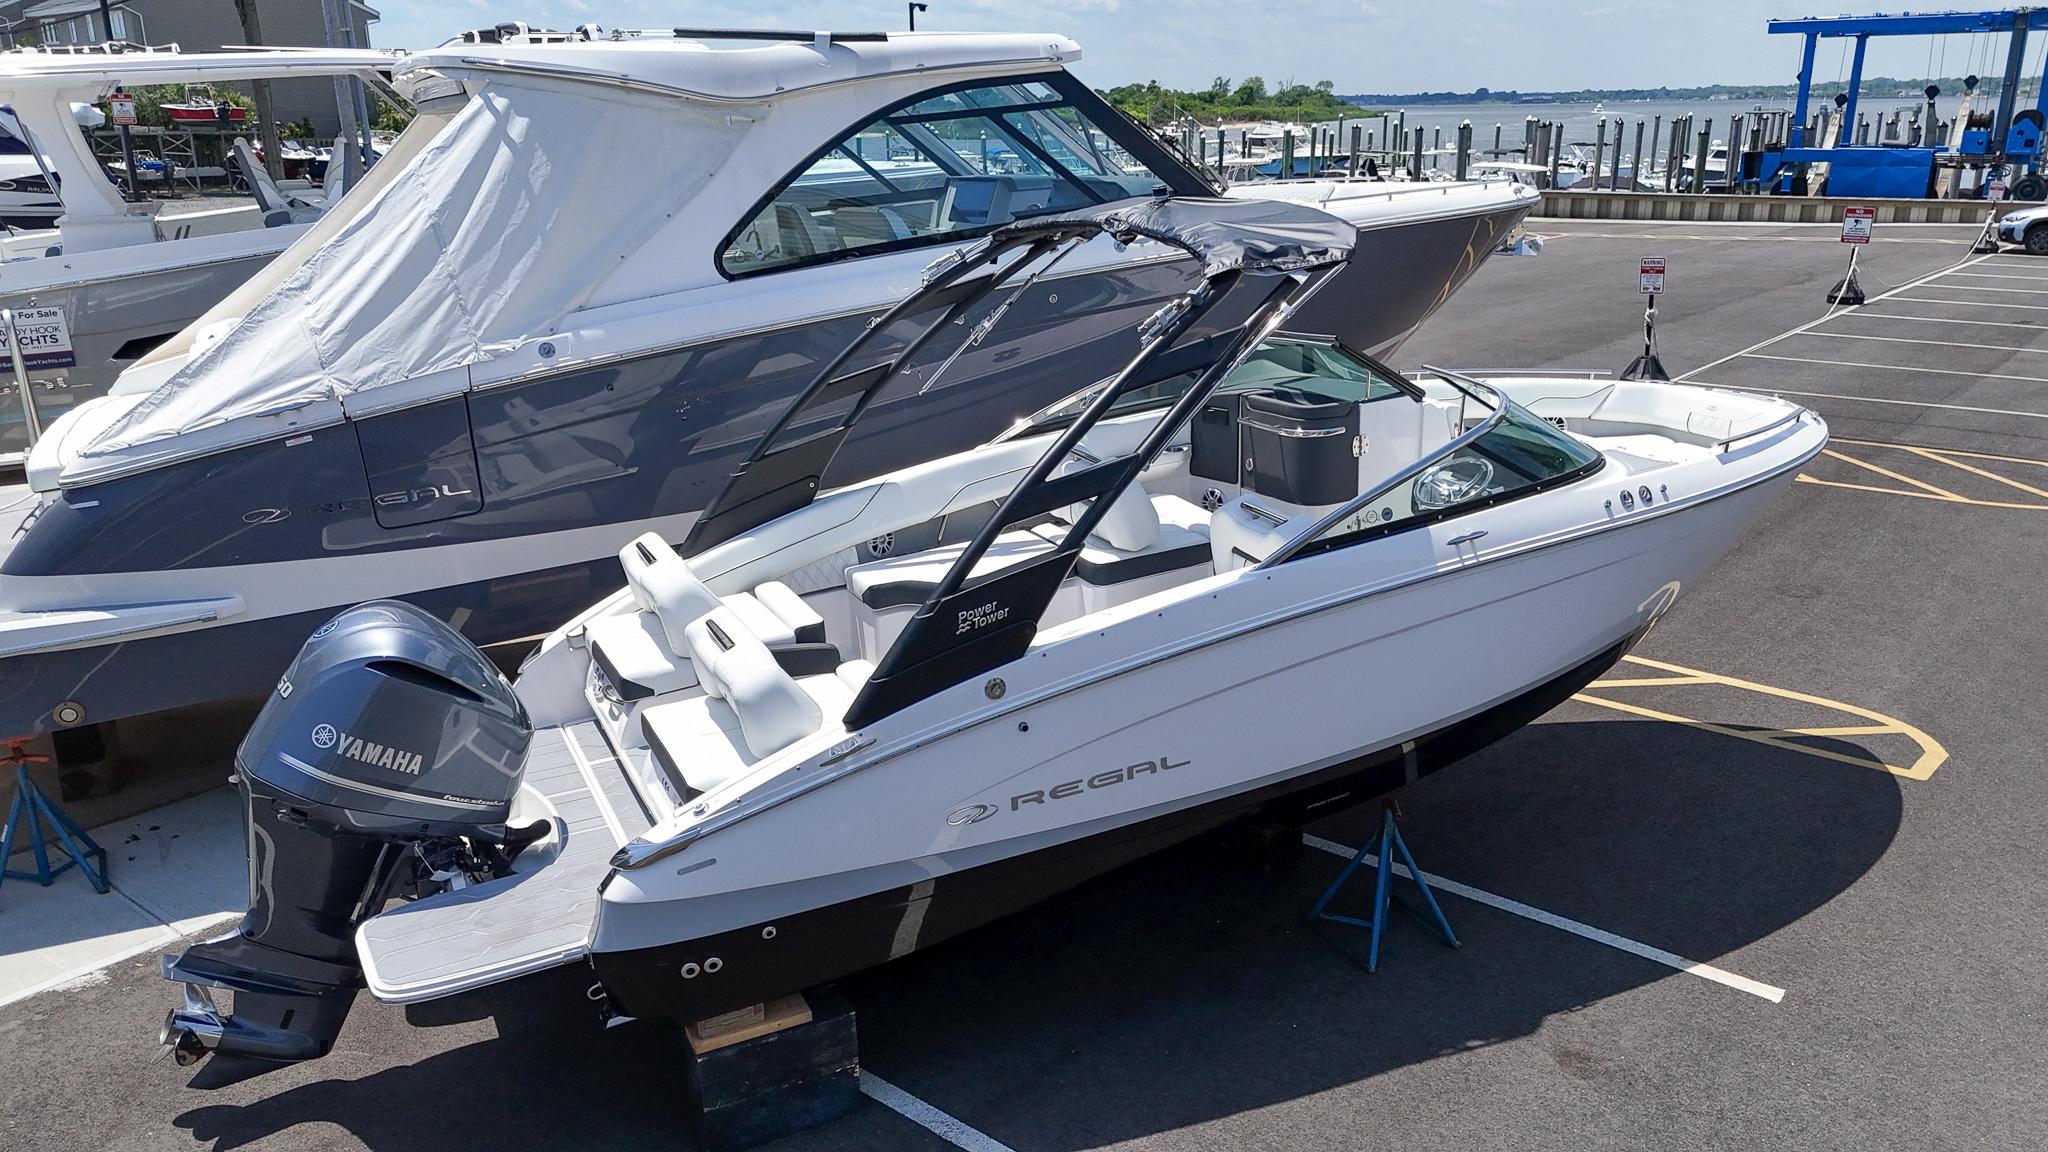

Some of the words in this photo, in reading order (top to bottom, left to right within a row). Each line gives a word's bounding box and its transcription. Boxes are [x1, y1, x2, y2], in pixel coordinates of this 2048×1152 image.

[18, 311, 34, 319] For
[36, 310, 58, 318] Sale
[0, 328, 27, 337] ADY
[30, 325, 61, 335] HOOK
[0, 334, 59, 347] YCHTS
[958, 601, 997, 624] Power
[973, 607, 1010, 629] Tower
[336, 732, 423, 776] YAMAHA
[1010, 756, 1191, 811] REGAL
